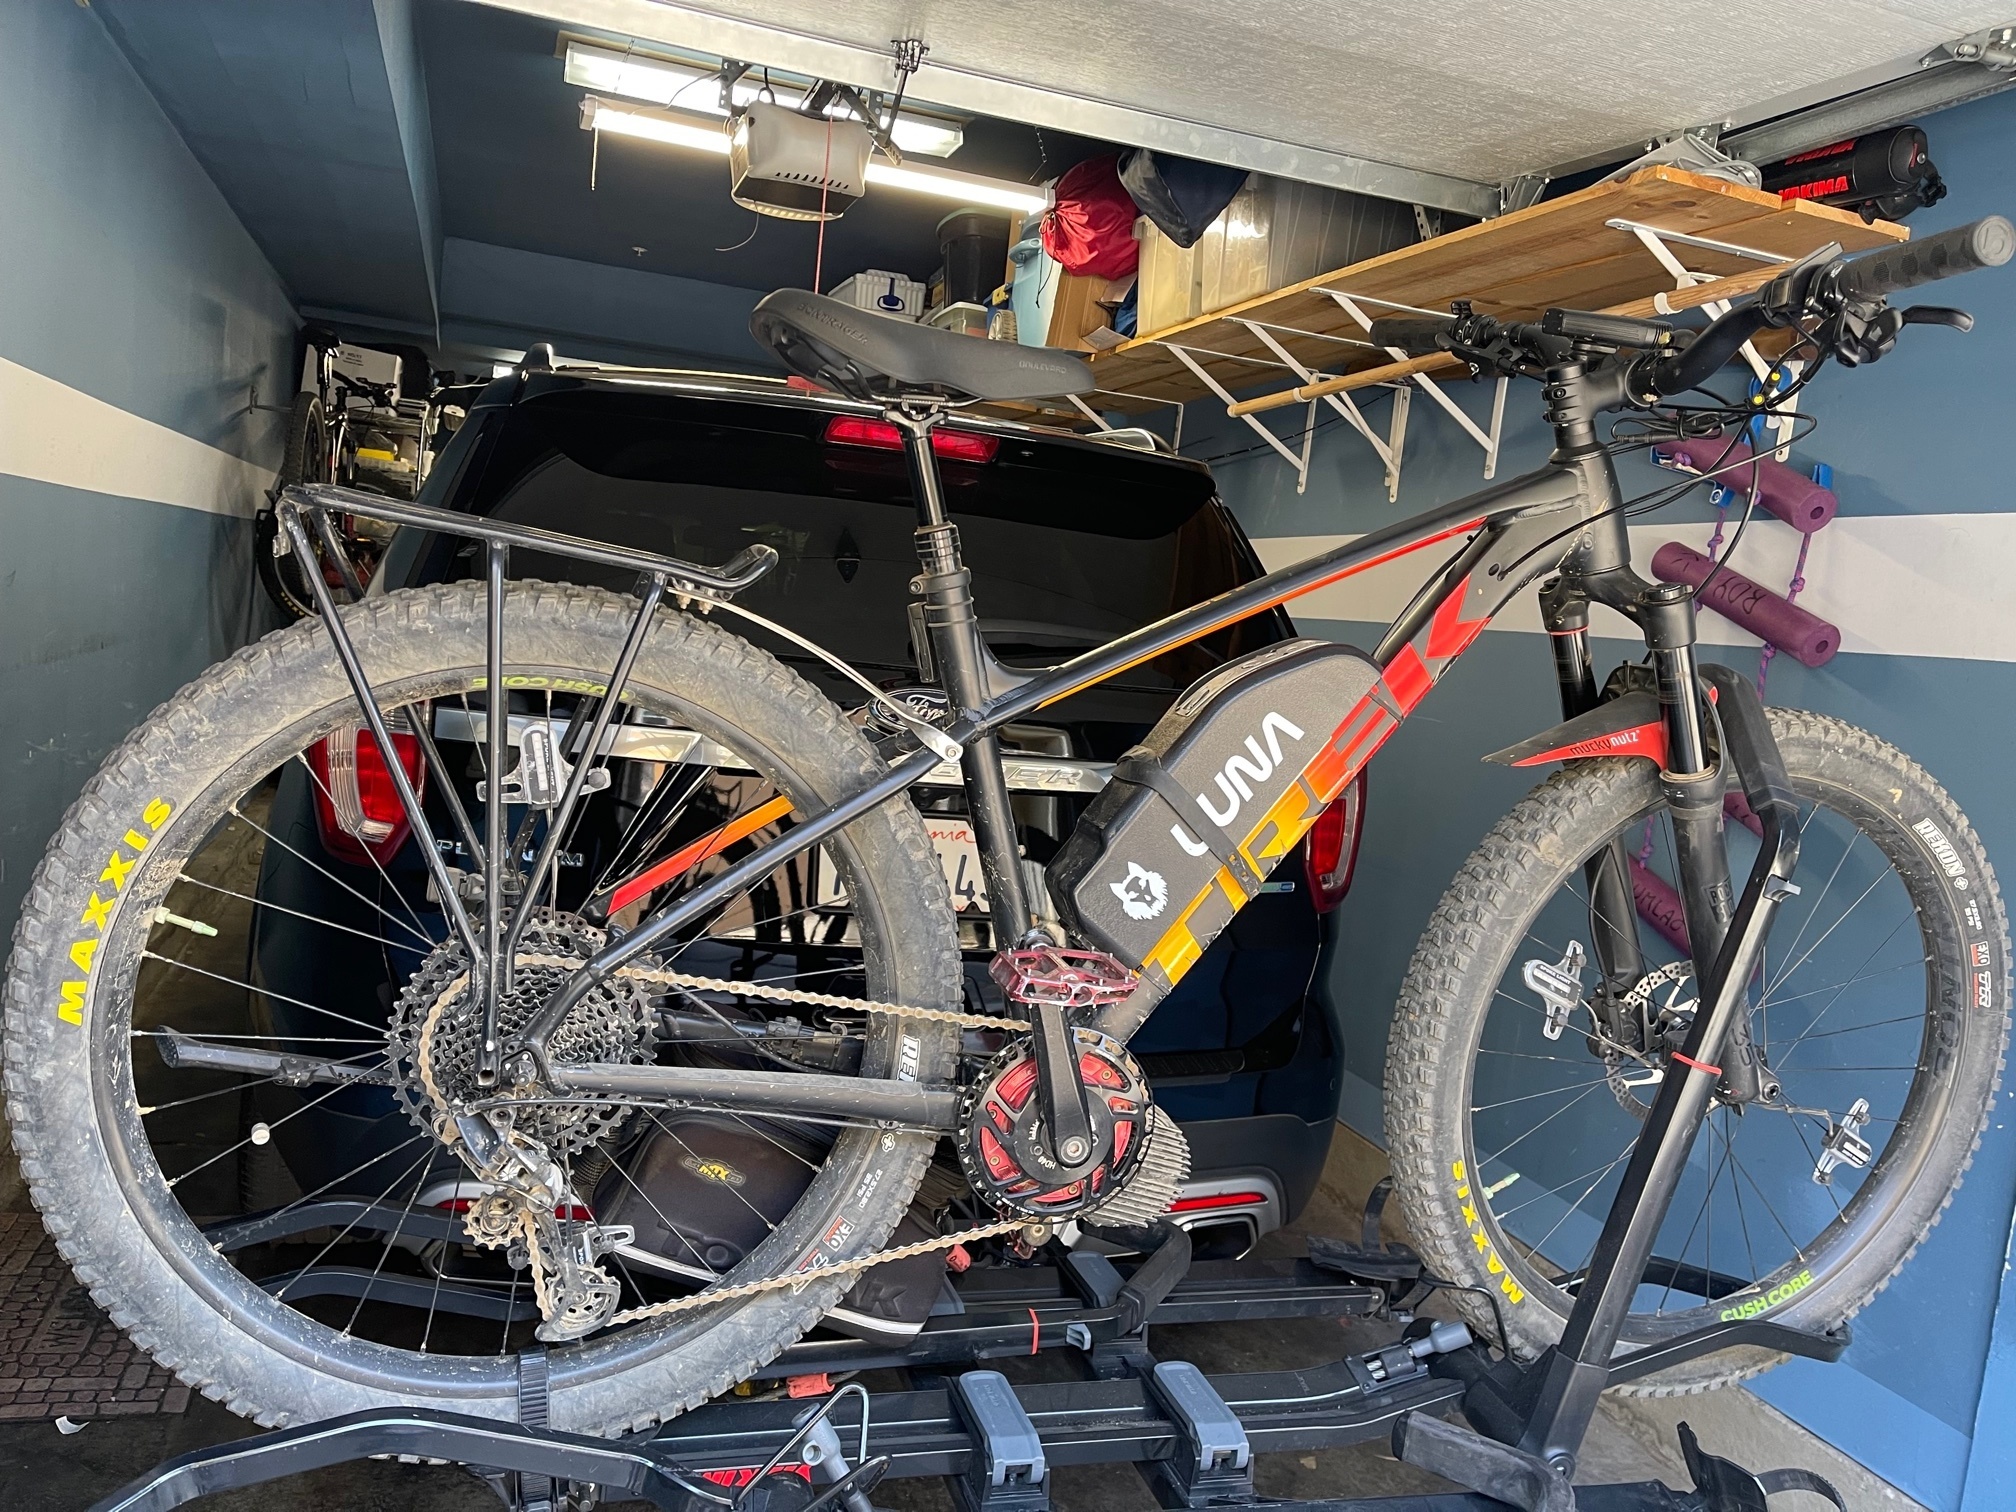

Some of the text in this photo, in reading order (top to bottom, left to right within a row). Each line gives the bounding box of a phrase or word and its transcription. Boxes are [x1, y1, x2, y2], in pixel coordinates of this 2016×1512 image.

[1777, 176, 1849, 202] YAKIMA
[1912, 817, 1966, 877] REKON
[57, 797, 172, 1027] MAXXIS
[1452, 1159, 1525, 1305] MAXXIS
[1720, 1269, 1812, 1323] CUSH CORE
